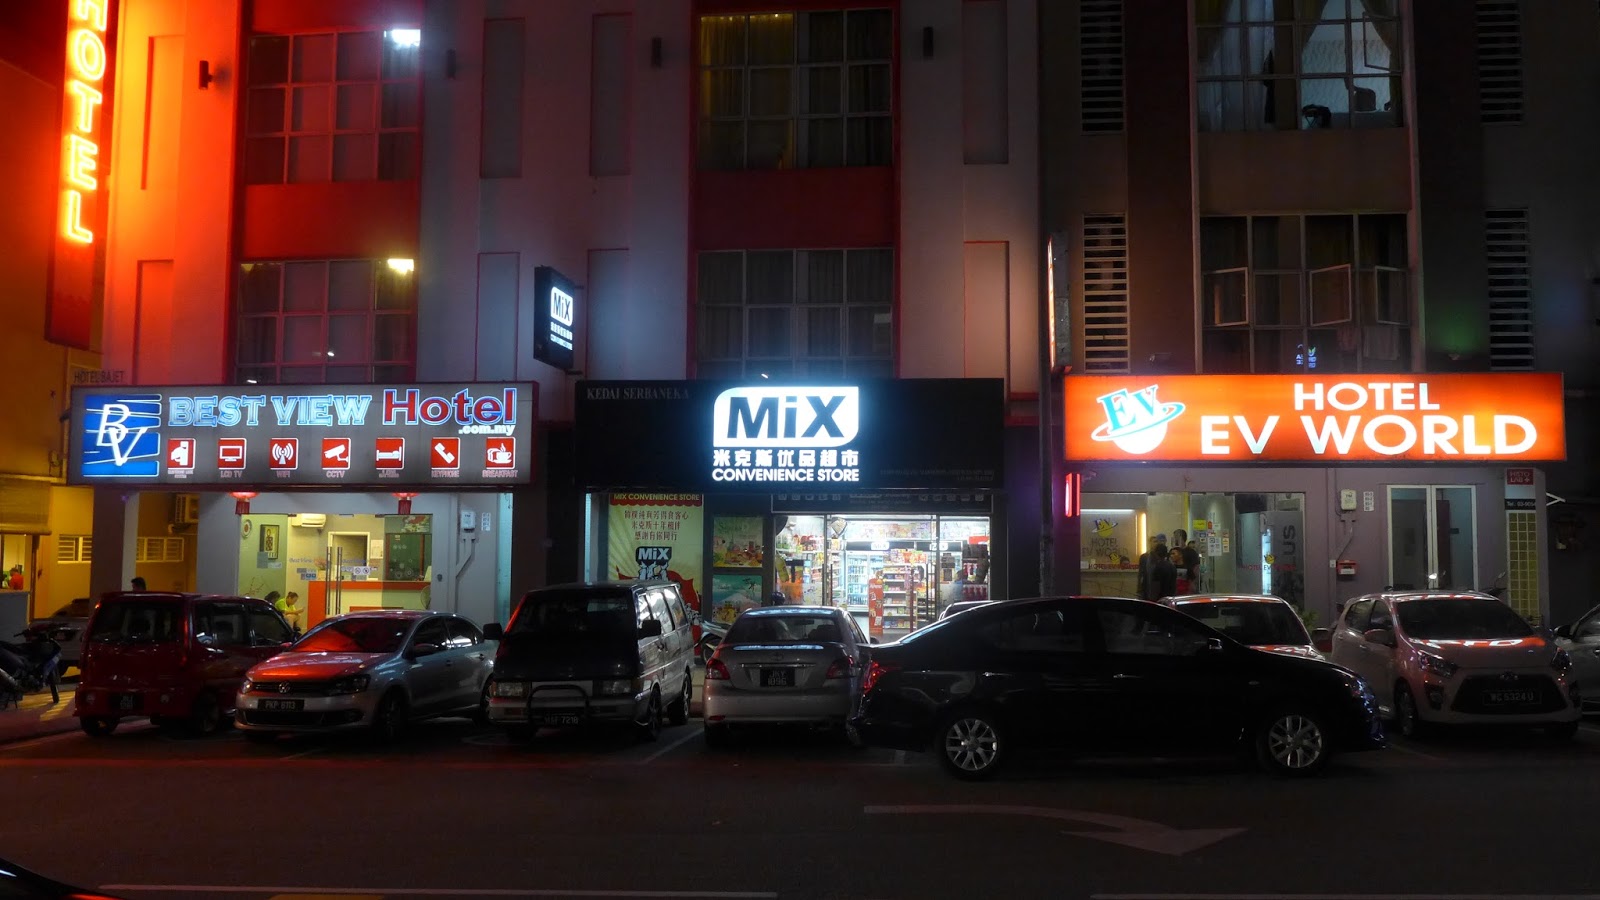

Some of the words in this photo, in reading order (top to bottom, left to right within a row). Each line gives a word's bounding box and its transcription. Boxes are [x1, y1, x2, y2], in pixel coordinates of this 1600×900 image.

[65, 0, 108, 244] HOTEL
[553, 292, 571, 322] MiX
[74, 371, 98, 383] HOTEL
[586, 387, 619, 400] KEDAI
[623, 387, 689, 400] SERBANEKA
[1294, 382, 1440, 410] HOTEL
[168, 395, 266, 427] BEST
[271, 395, 372, 427] VIEW
[382, 388, 517, 426] Hotel
[726, 395, 847, 439] MiX
[458, 425, 515, 436] .com.my
[1201, 415, 1280, 455] EV
[1299, 415, 1538, 456] WORLD
[713, 449, 859, 467] 米克斯优品超市
[220, 470, 232, 478] LCD
[234, 470, 243, 478] TV
[276, 470, 290, 478] WIFI
[326, 470, 345, 478] CCTV
[482, 469, 518, 478] BREAKFAST
[712, 468, 814, 482] CONVENIENCE
[817, 468, 859, 482] STORE
[680, 493, 700, 501] STORE
[1091, 538, 1117, 547] HOTEL
[638, 547, 670, 560] MiX
